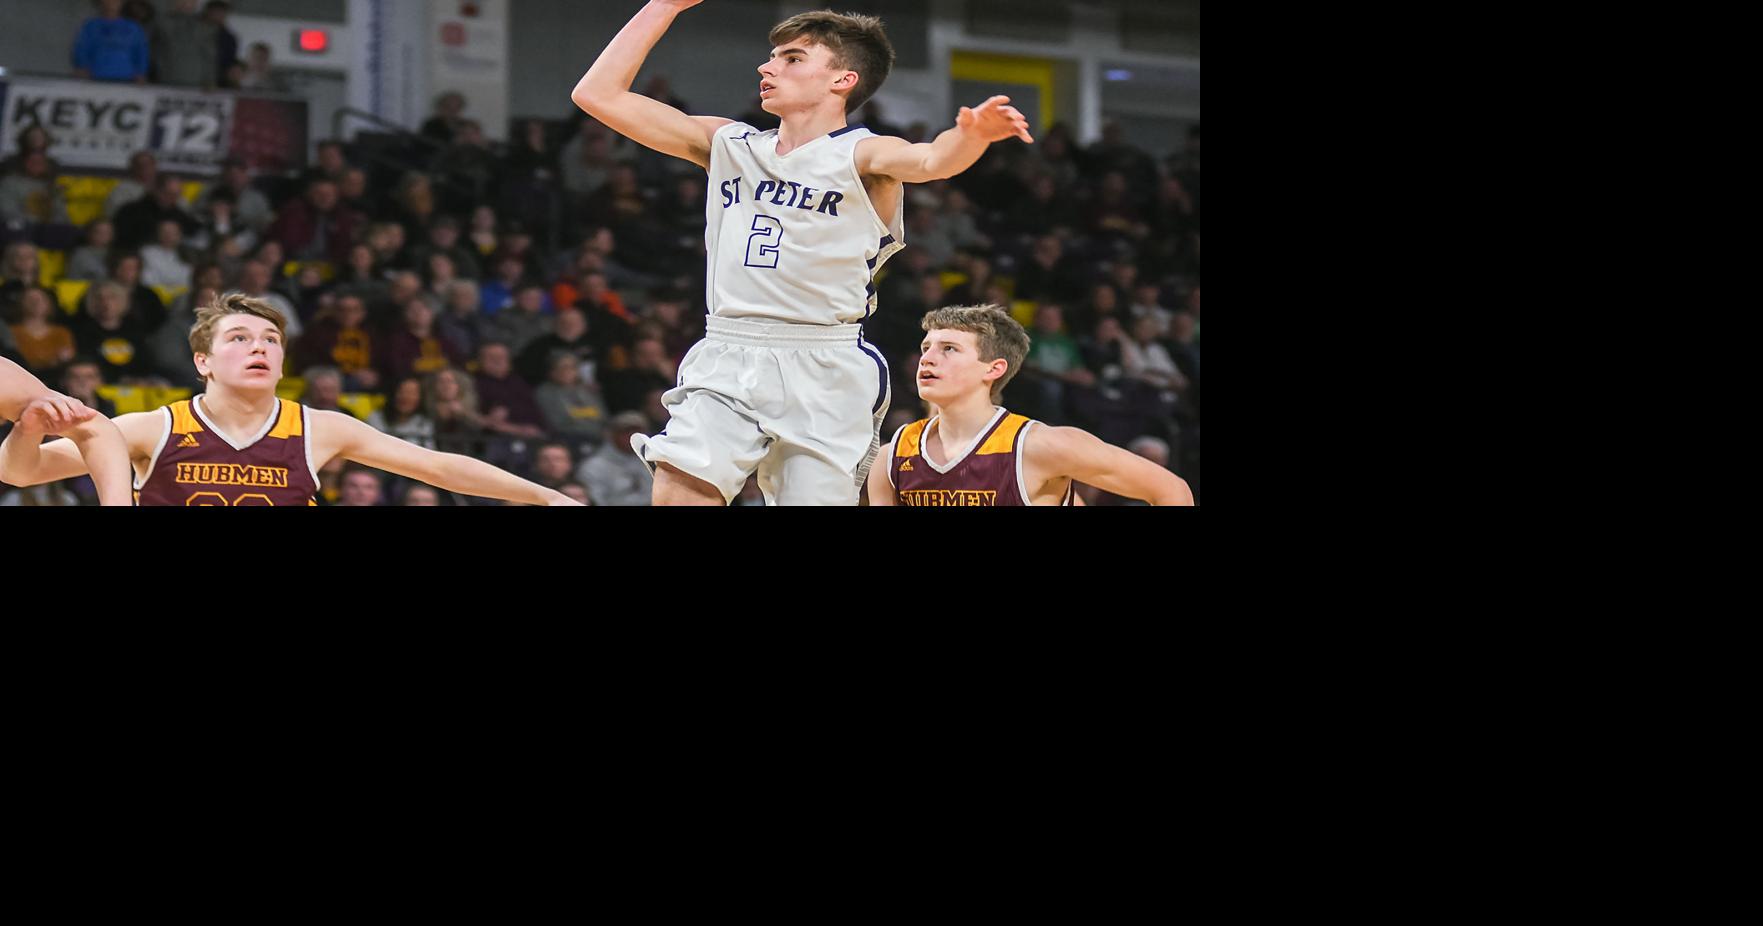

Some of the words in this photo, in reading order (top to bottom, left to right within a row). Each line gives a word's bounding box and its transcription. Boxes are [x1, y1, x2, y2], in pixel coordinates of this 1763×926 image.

[14, 96, 142, 131] KEYC
[159, 112, 218, 149] 12
[720, 176, 742, 209] ST
[754, 179, 844, 217] PETER
[744, 214, 784, 269] 2
[175, 462, 289, 488] HUBMEN
